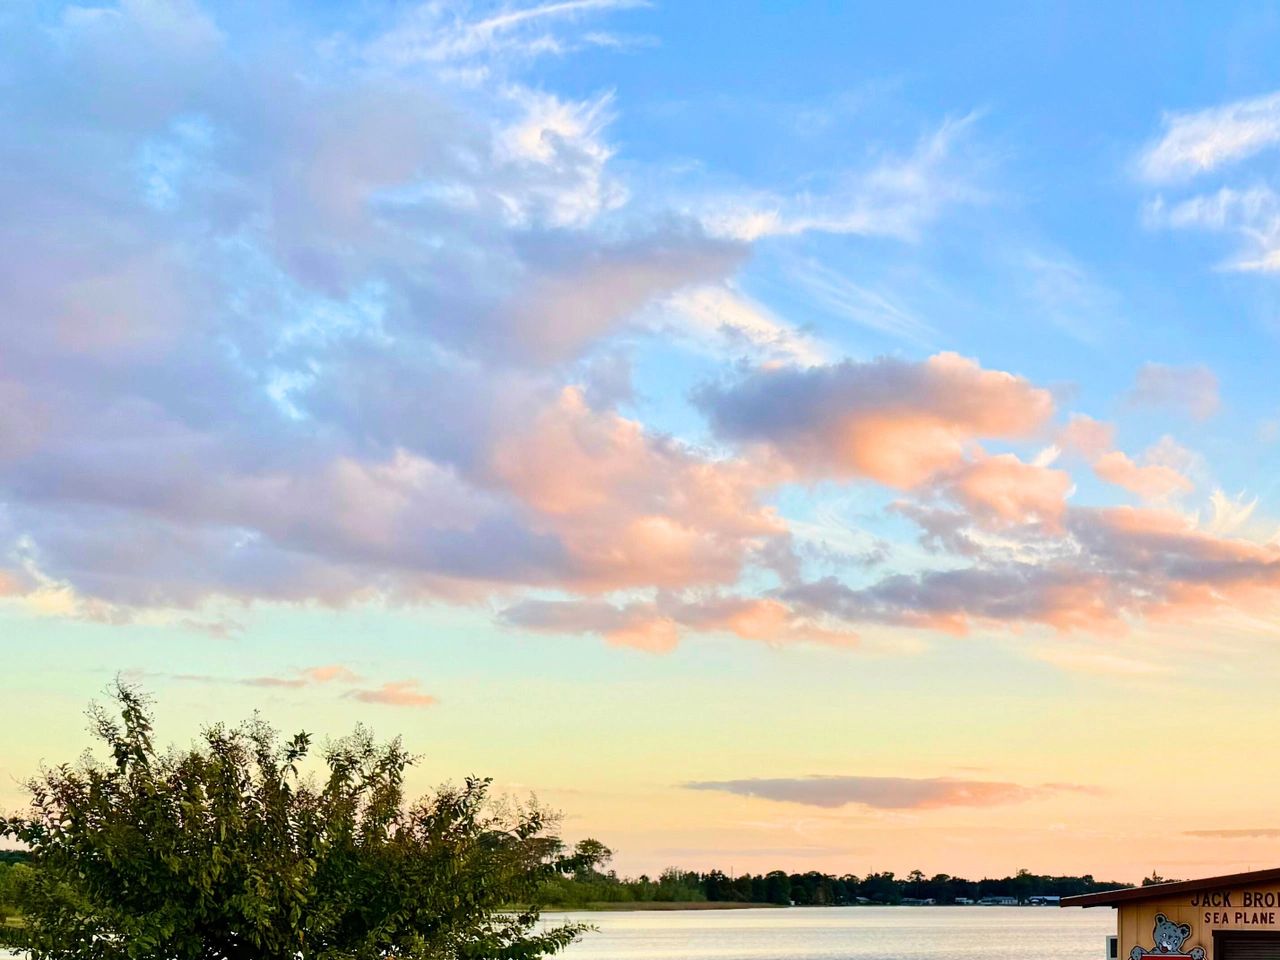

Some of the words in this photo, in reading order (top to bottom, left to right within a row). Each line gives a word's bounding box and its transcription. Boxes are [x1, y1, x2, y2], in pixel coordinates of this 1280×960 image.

[1191, 891, 1232, 907] JACK
[1204, 912, 1229, 924] SEA
[1235, 912, 1275, 924] PLANE
